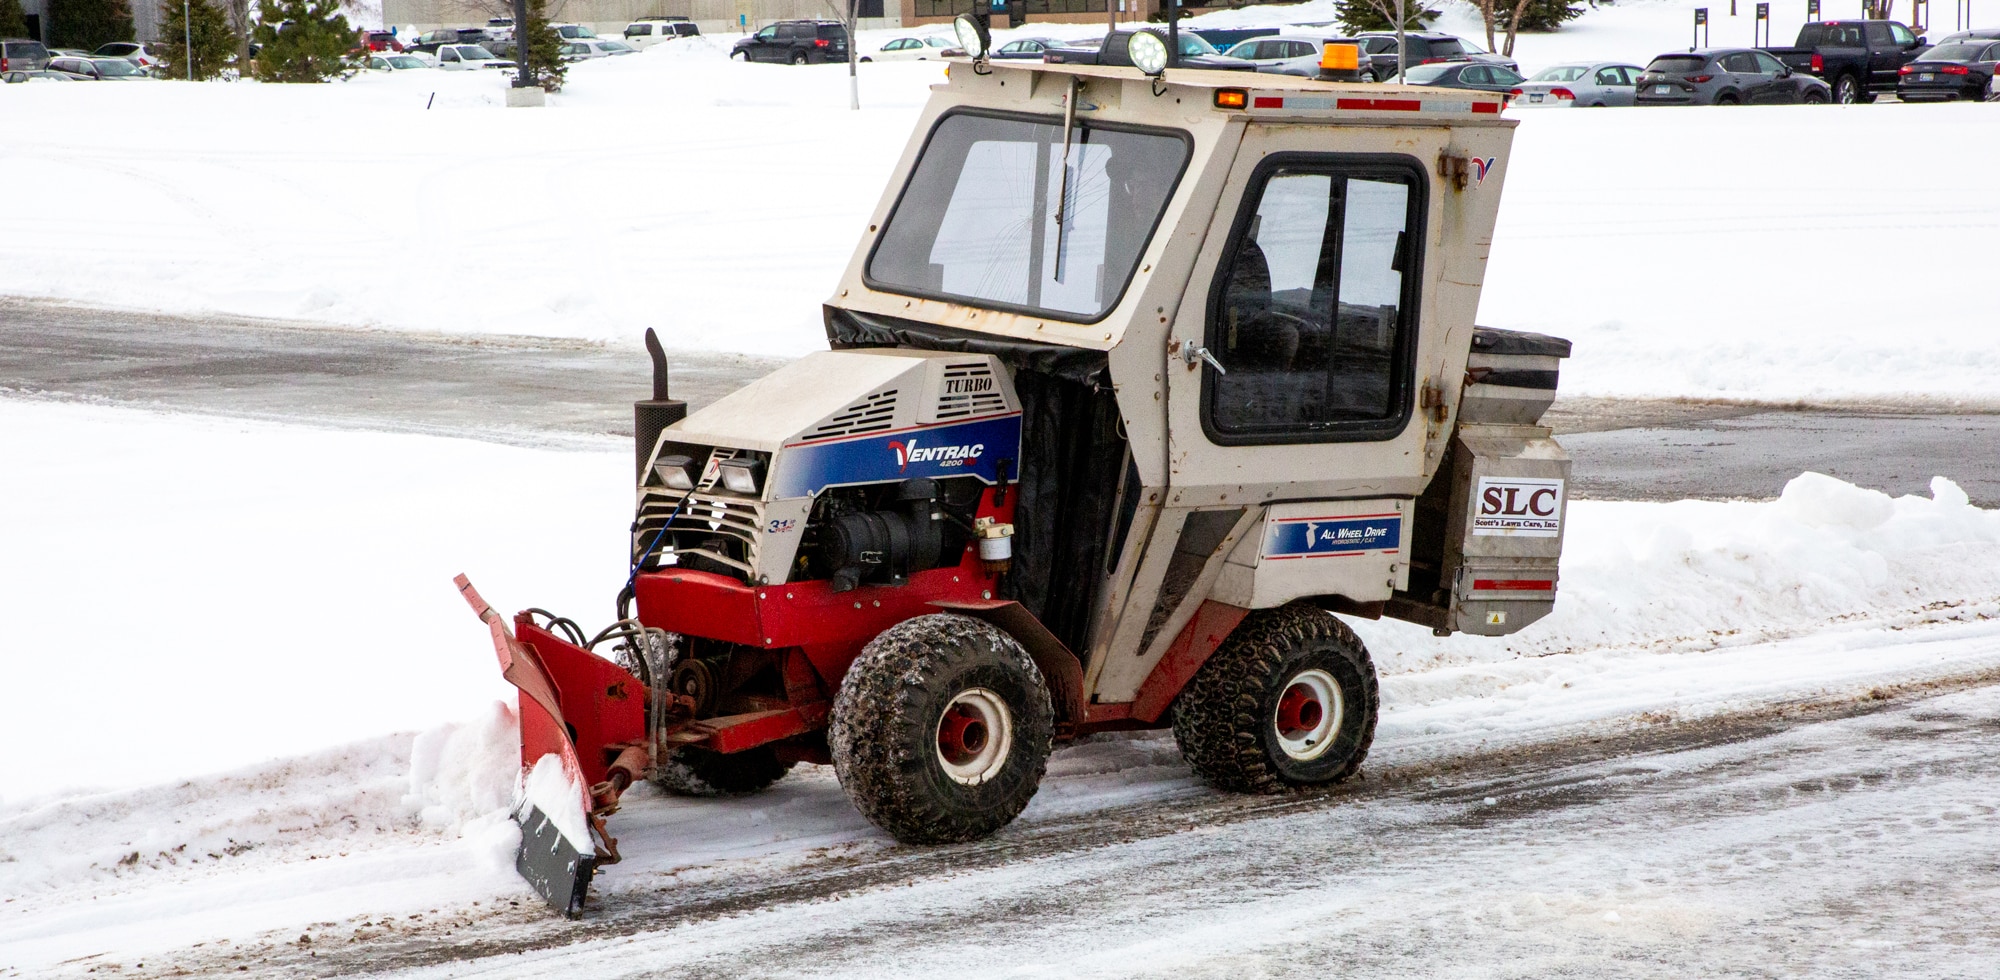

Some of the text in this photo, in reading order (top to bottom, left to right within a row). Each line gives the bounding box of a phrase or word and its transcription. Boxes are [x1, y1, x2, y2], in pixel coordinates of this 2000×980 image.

[946, 378, 992, 393] TURBO
[888, 439, 984, 474] VENTRAC
[940, 459, 963, 467] 4200
[1481, 487, 1557, 516] SLC
[1523, 520, 1542, 528] Care,
[1320, 527, 1387, 540] ALL WHEEL DRIVE
